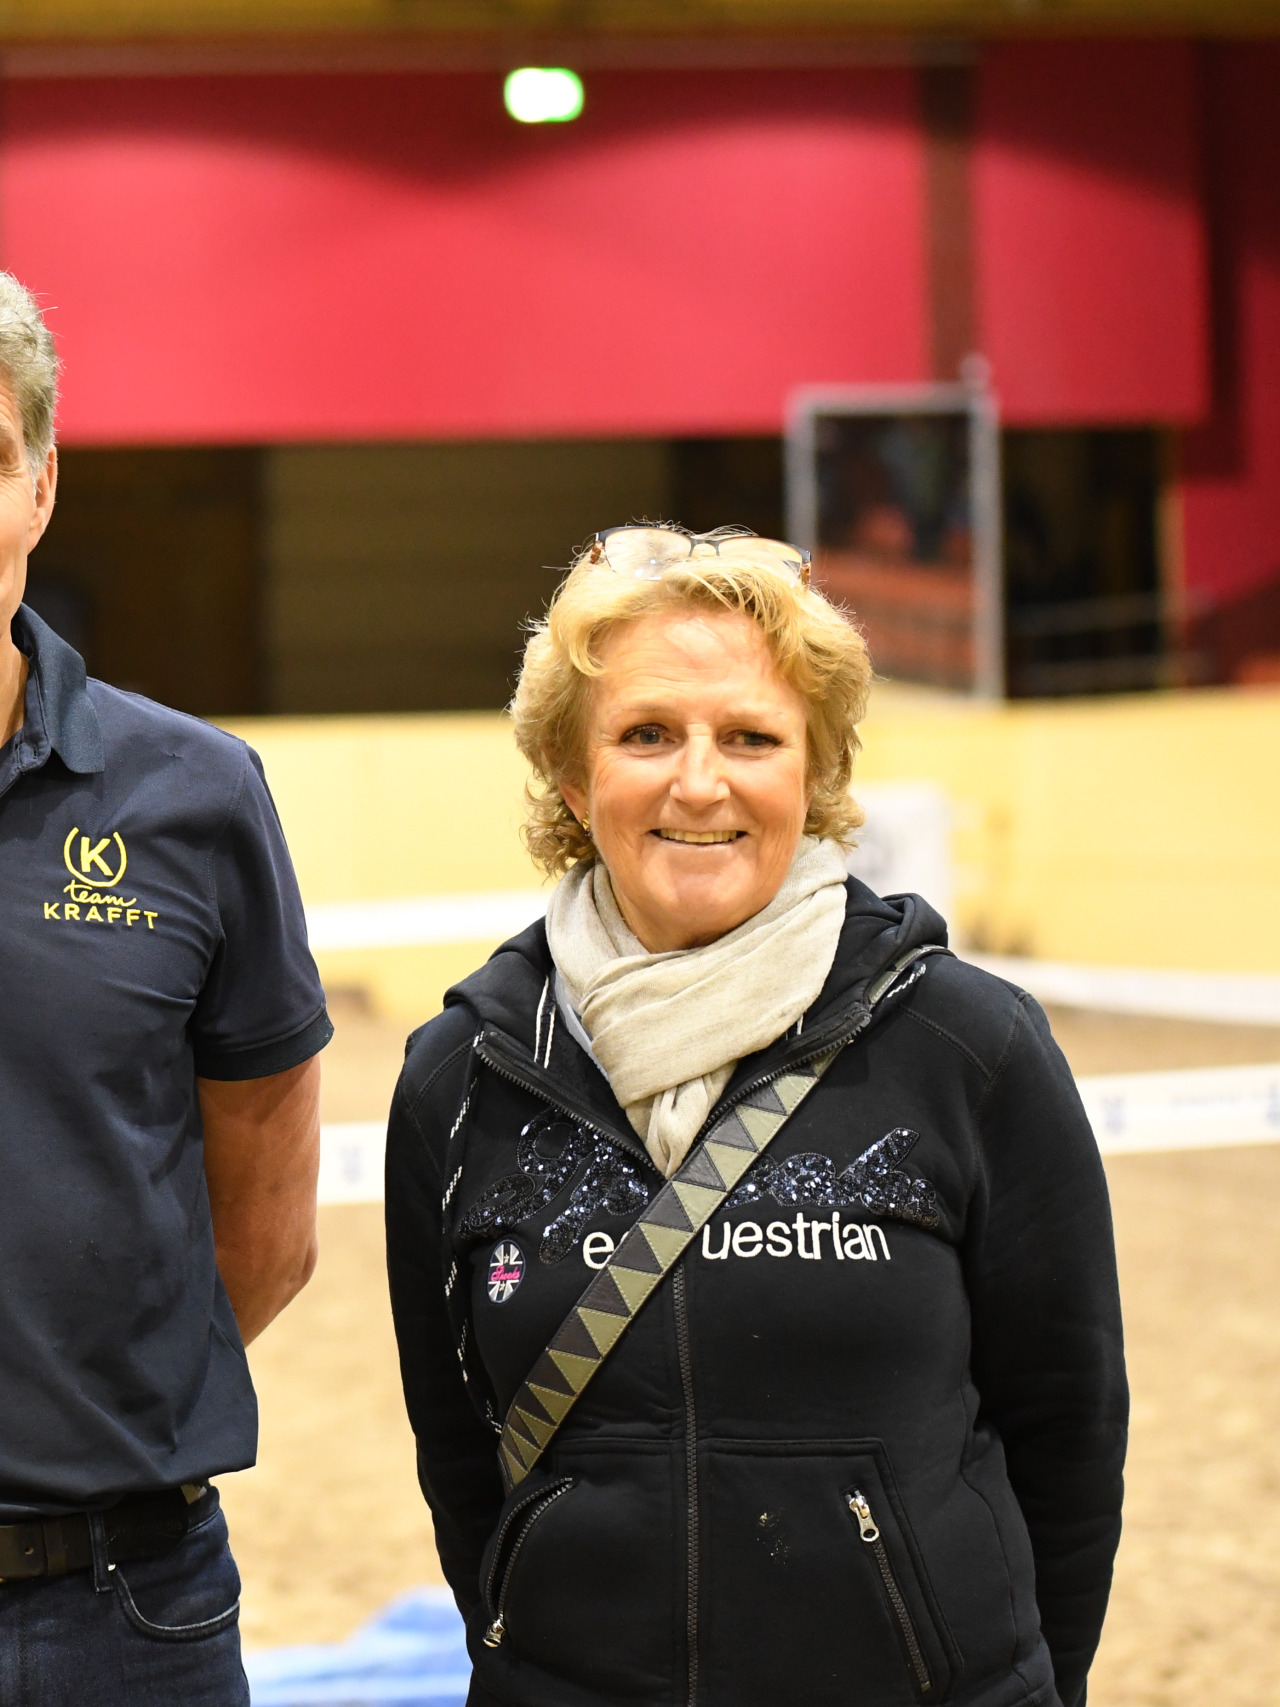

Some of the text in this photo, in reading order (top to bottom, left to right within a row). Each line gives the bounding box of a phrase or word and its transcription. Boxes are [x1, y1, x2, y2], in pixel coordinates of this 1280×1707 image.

[80, 836, 114, 876] K
[63, 879, 137, 907] team
[43, 902, 158, 929] KRAFFT
[582, 1211, 891, 1270] euestrian
